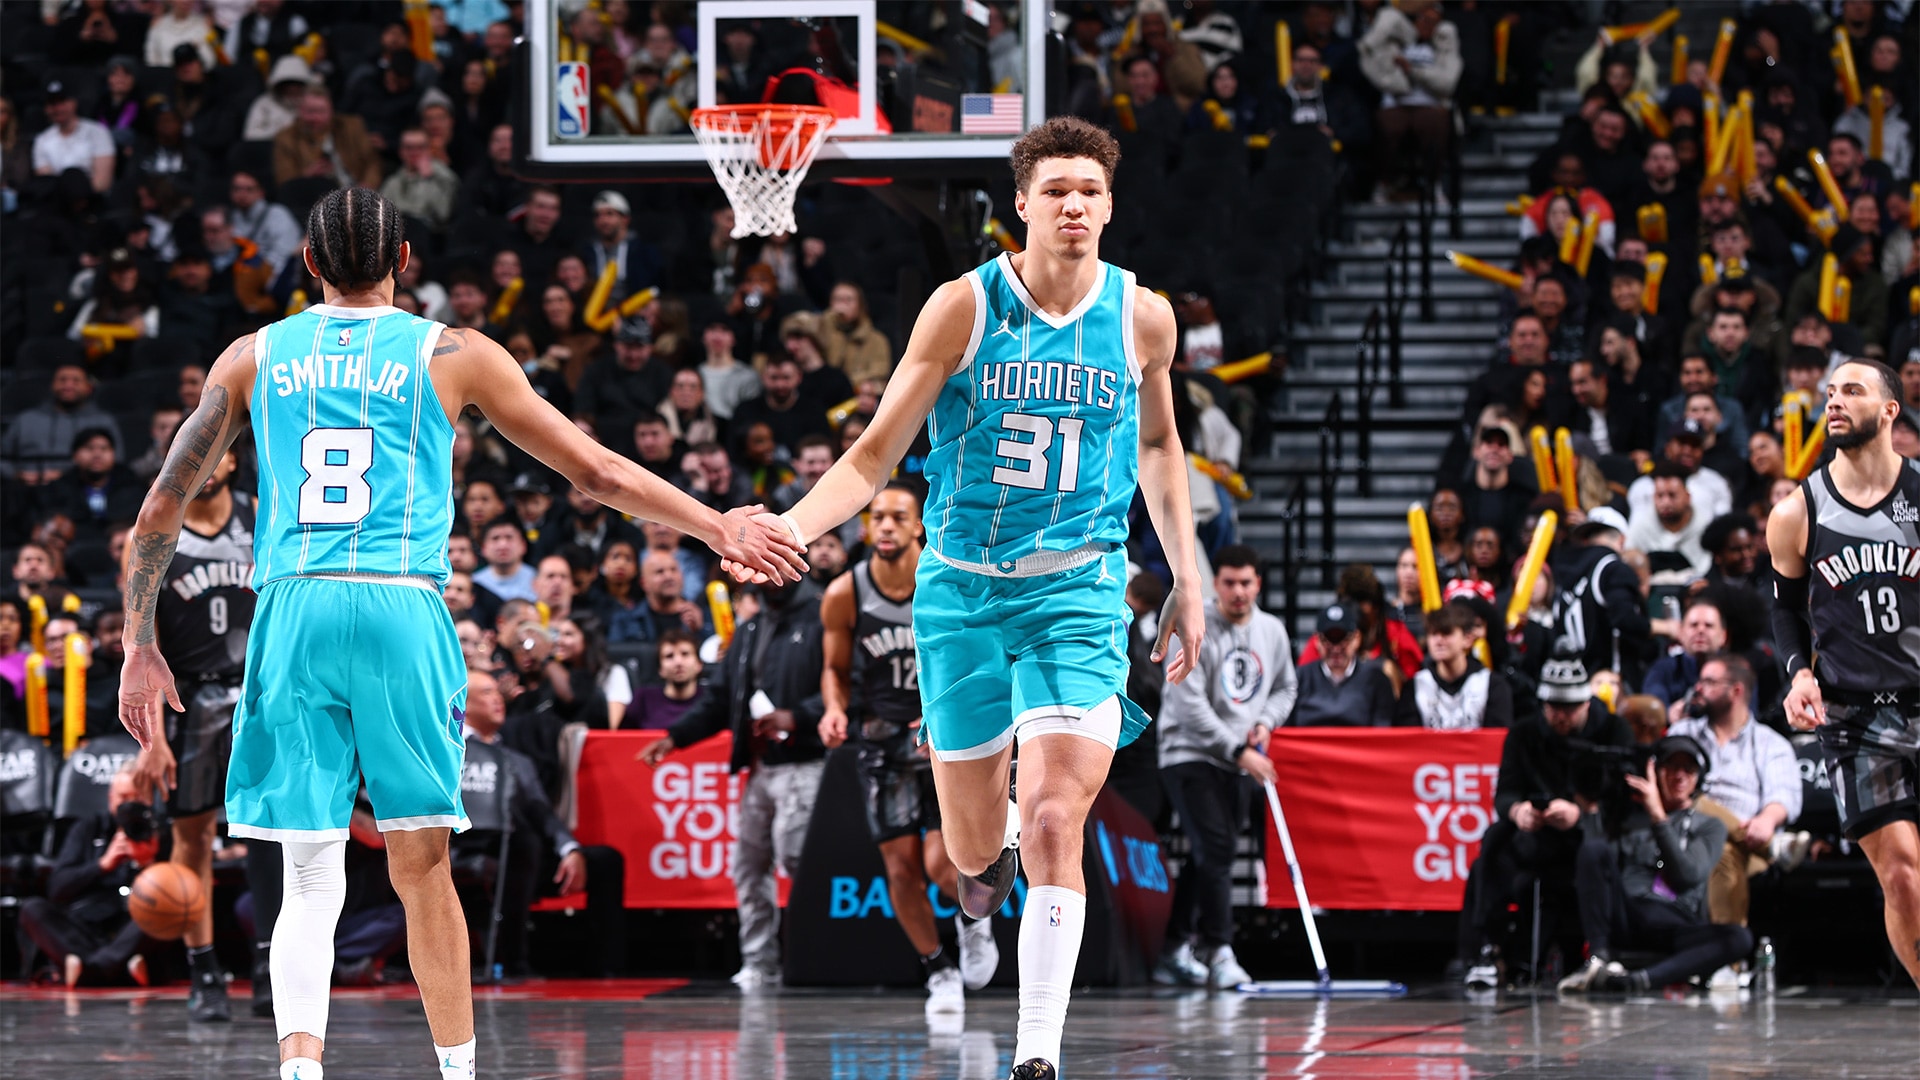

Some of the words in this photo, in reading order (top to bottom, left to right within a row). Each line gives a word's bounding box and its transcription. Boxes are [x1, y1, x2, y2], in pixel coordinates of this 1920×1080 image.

[271, 354, 364, 398] SMITH
[367, 359, 410, 404] JR.
[979, 361, 1119, 411] HORNETS
[298, 427, 374, 524] 8
[991, 412, 1085, 492] 31
[209, 595, 228, 635] 9
[1858, 586, 1901, 635] 13
[889, 655, 918, 690] 12
